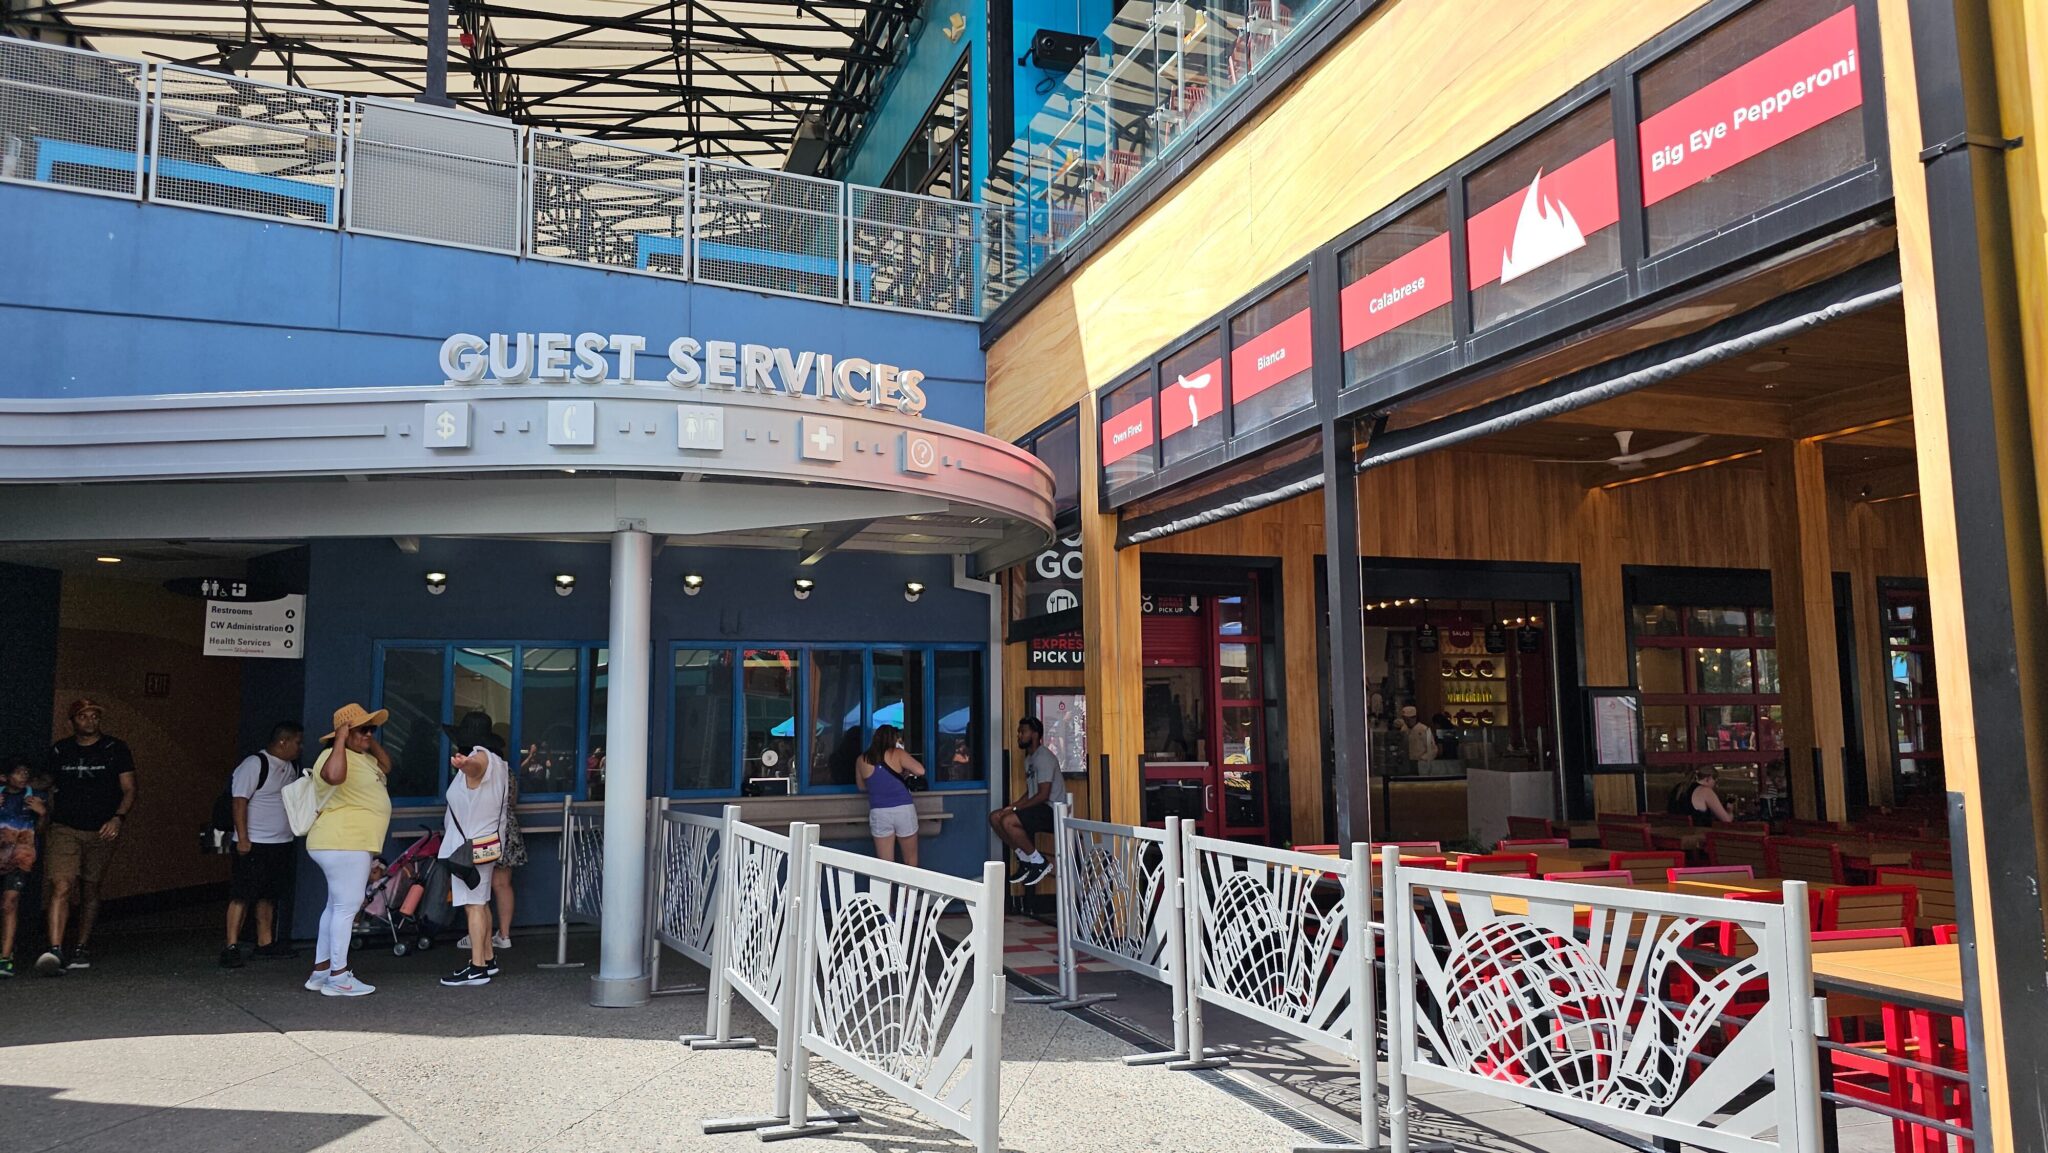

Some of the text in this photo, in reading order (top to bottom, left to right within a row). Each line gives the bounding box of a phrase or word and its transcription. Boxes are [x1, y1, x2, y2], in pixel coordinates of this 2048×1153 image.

[1650, 49, 1857, 172] Big Eye Pepperoni
[1368, 276, 1426, 314] Calabrese
[1257, 347, 1286, 371] Bianca
[439, 332, 928, 417] GUEST SERVICES
[1112, 420, 1143, 446] Oven Fired
[211, 606, 253, 616] Restrooms
[210, 621, 284, 632] CW Administration
[209, 637, 272, 648] Health Services
[1032, 638, 1084, 650] EXPRES
[1032, 650, 1085, 664] PICK U
